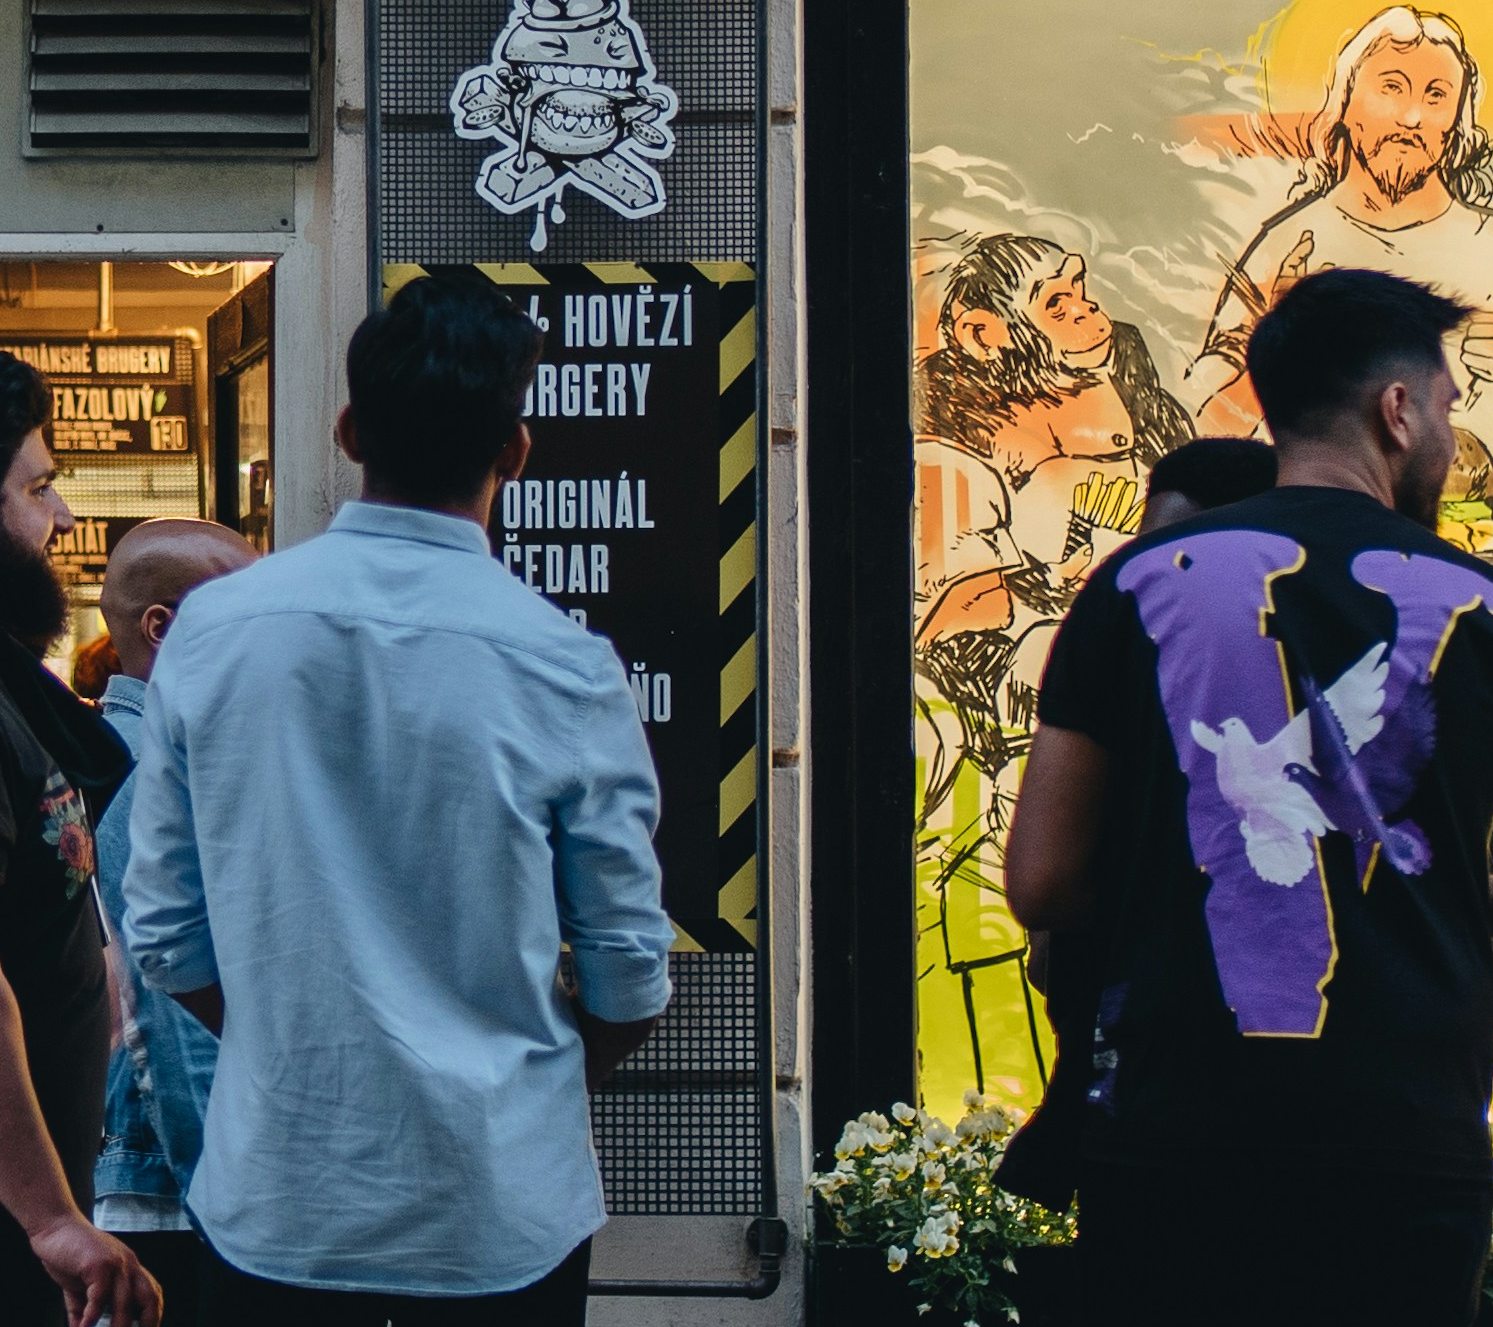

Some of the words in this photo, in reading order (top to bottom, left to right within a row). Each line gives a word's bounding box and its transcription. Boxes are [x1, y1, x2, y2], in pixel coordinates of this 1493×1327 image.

[564, 284, 694, 348] HOVĚZÍ
[53, 382, 155, 422] FAZOLOVÝ
[520, 362, 652, 417] RGERY
[502, 470, 656, 530] ORIGINÁL
[502, 532, 610, 594] ČEDAR
